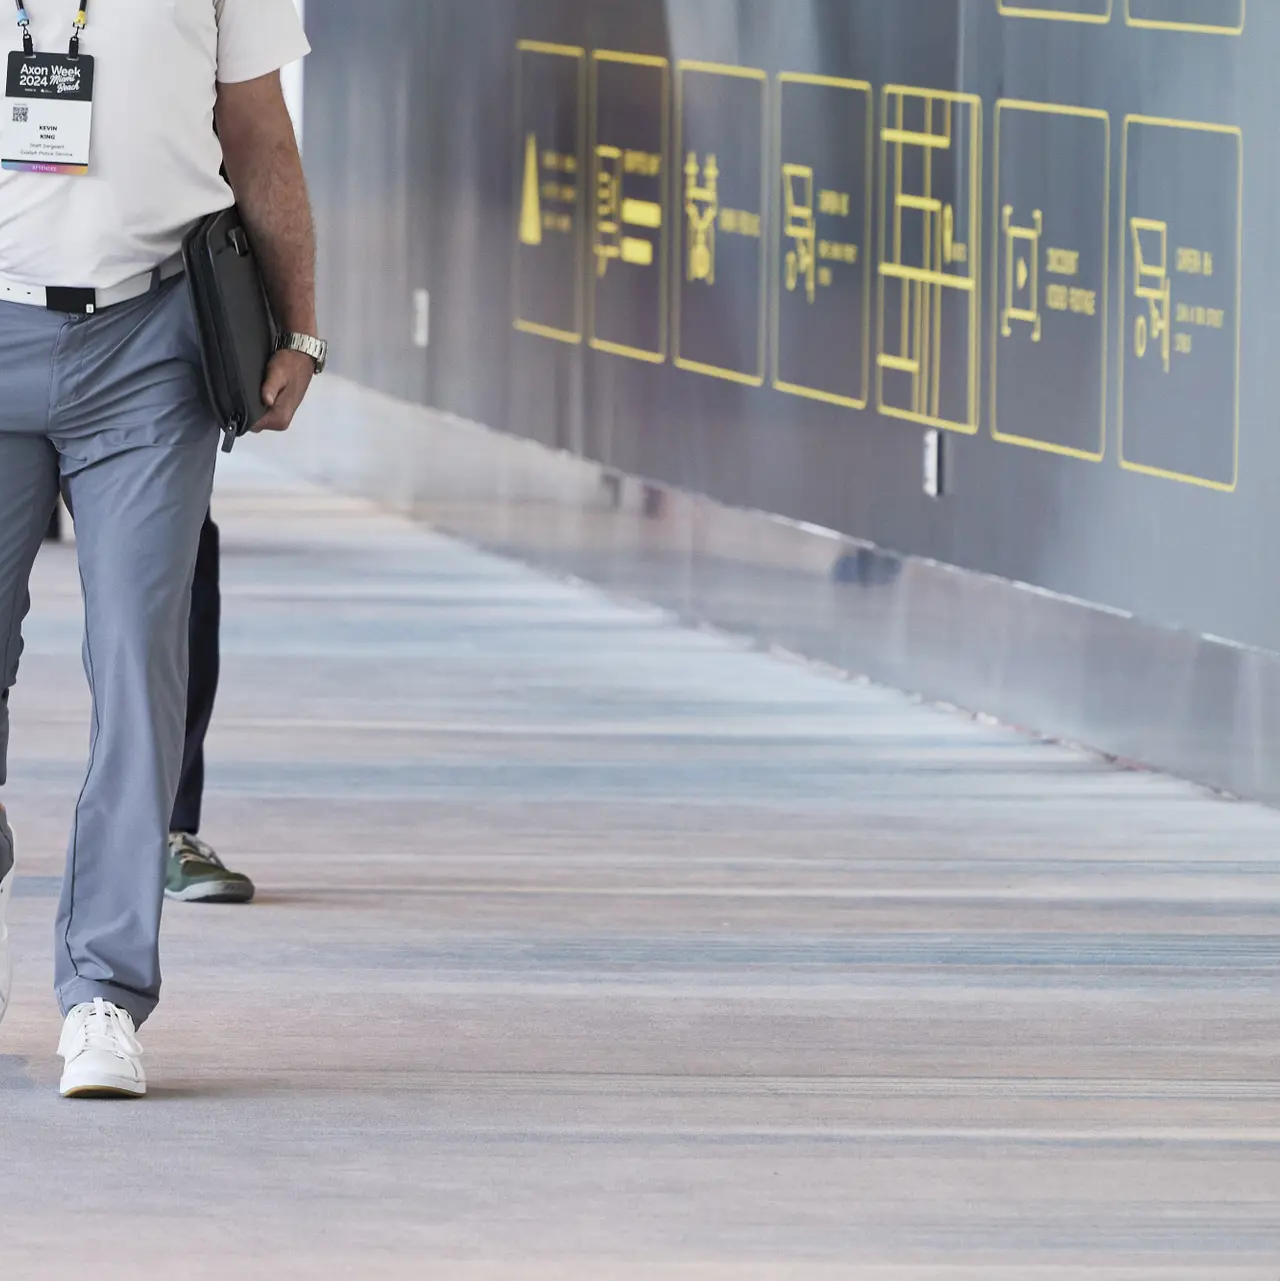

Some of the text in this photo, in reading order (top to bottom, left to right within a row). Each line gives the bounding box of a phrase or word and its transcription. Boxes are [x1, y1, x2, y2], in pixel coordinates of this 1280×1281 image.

[20, 63, 81, 78] Axon Week
[19, 73, 76, 87] 2024 Miami
[56, 79, 80, 94] Beach
